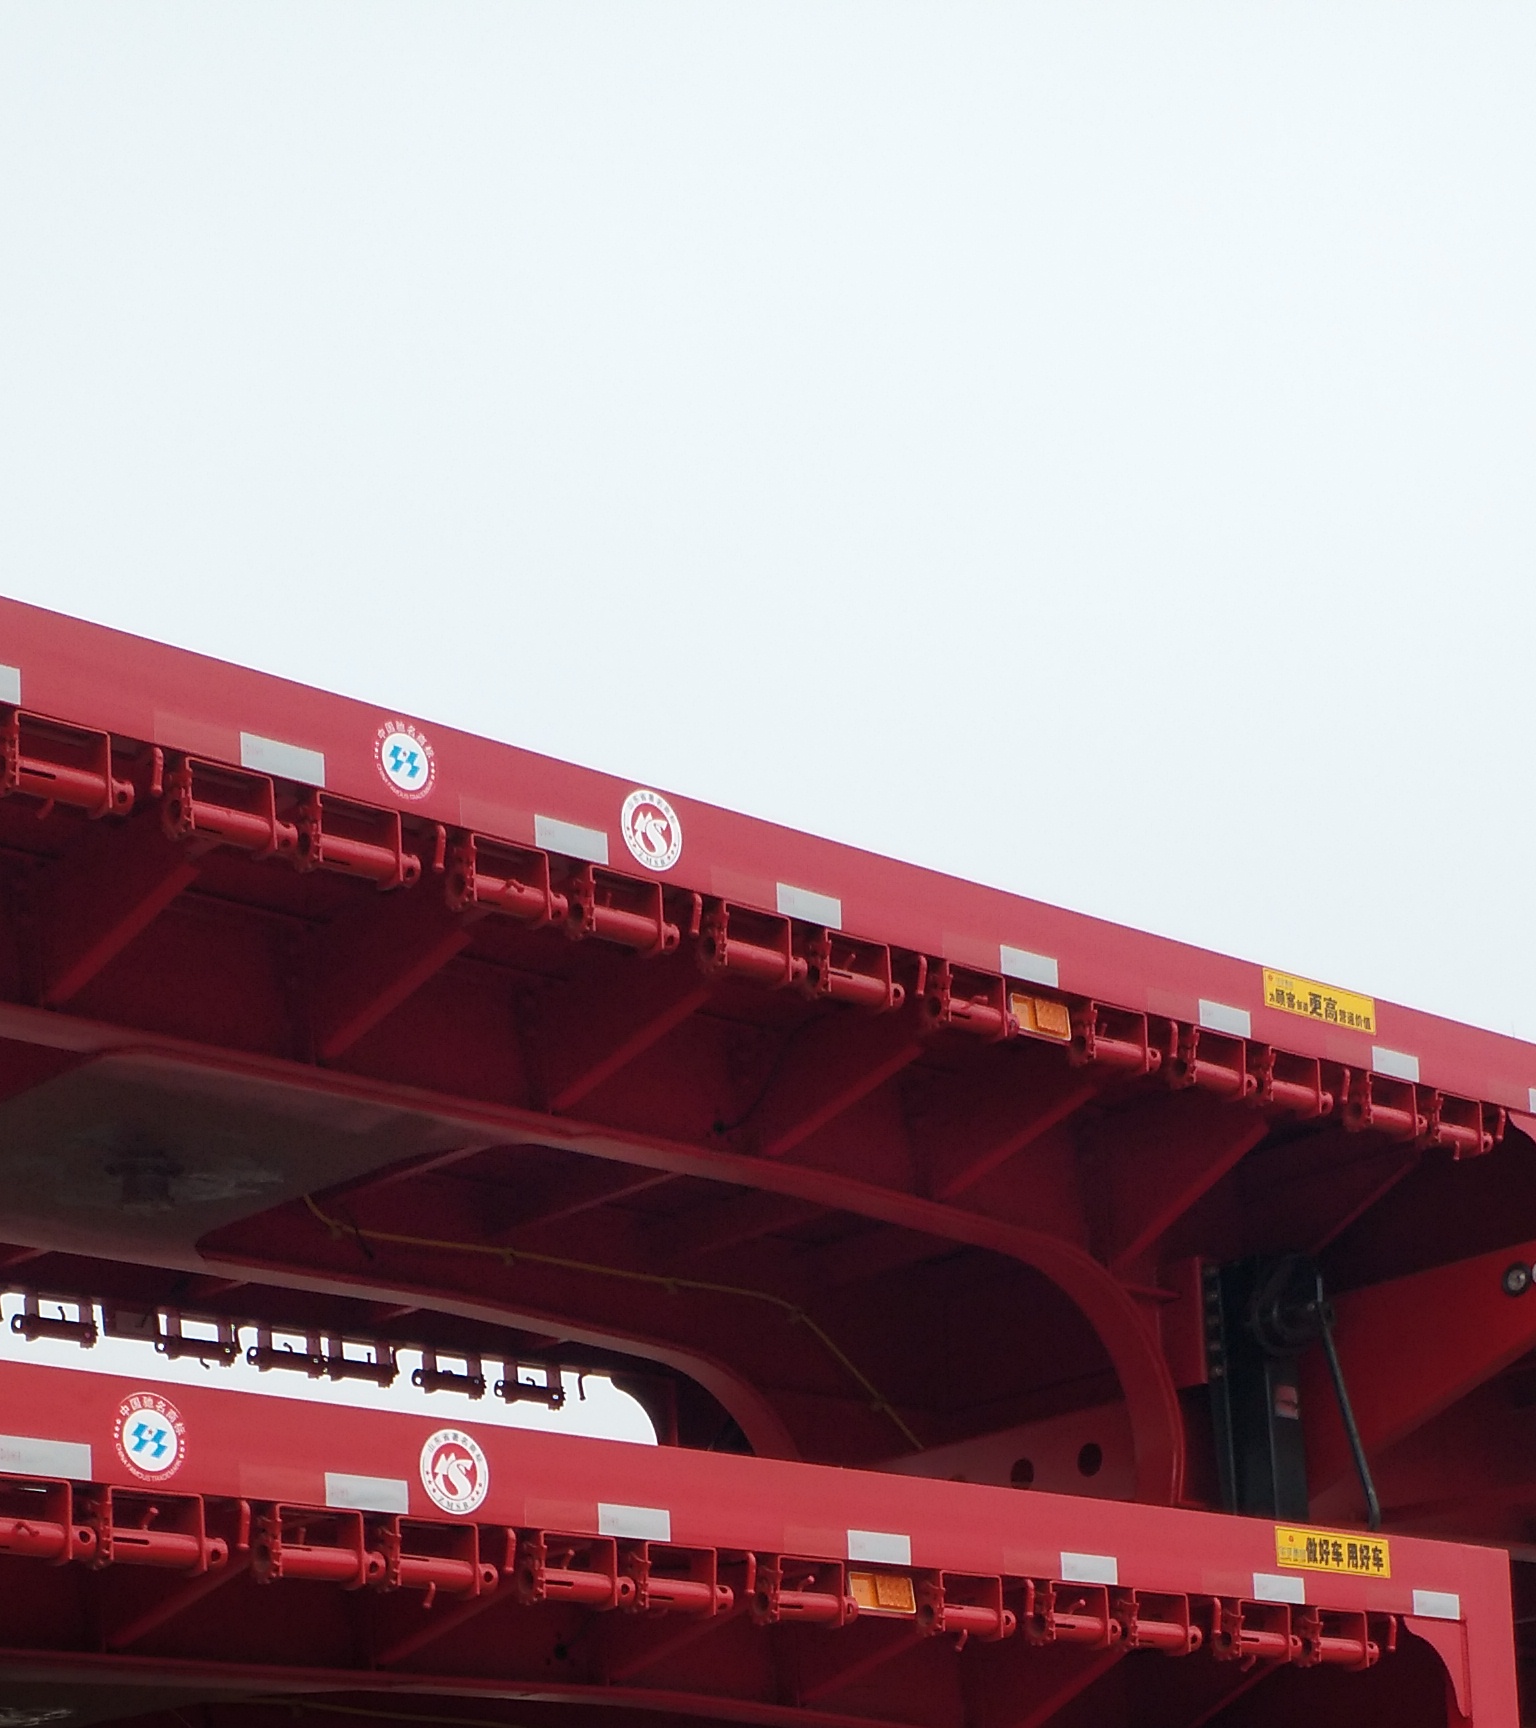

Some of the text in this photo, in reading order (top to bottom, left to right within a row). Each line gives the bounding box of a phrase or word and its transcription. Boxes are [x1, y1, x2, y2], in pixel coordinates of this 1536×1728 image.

[119, 1396, 186, 1435] 中国驰名商标
